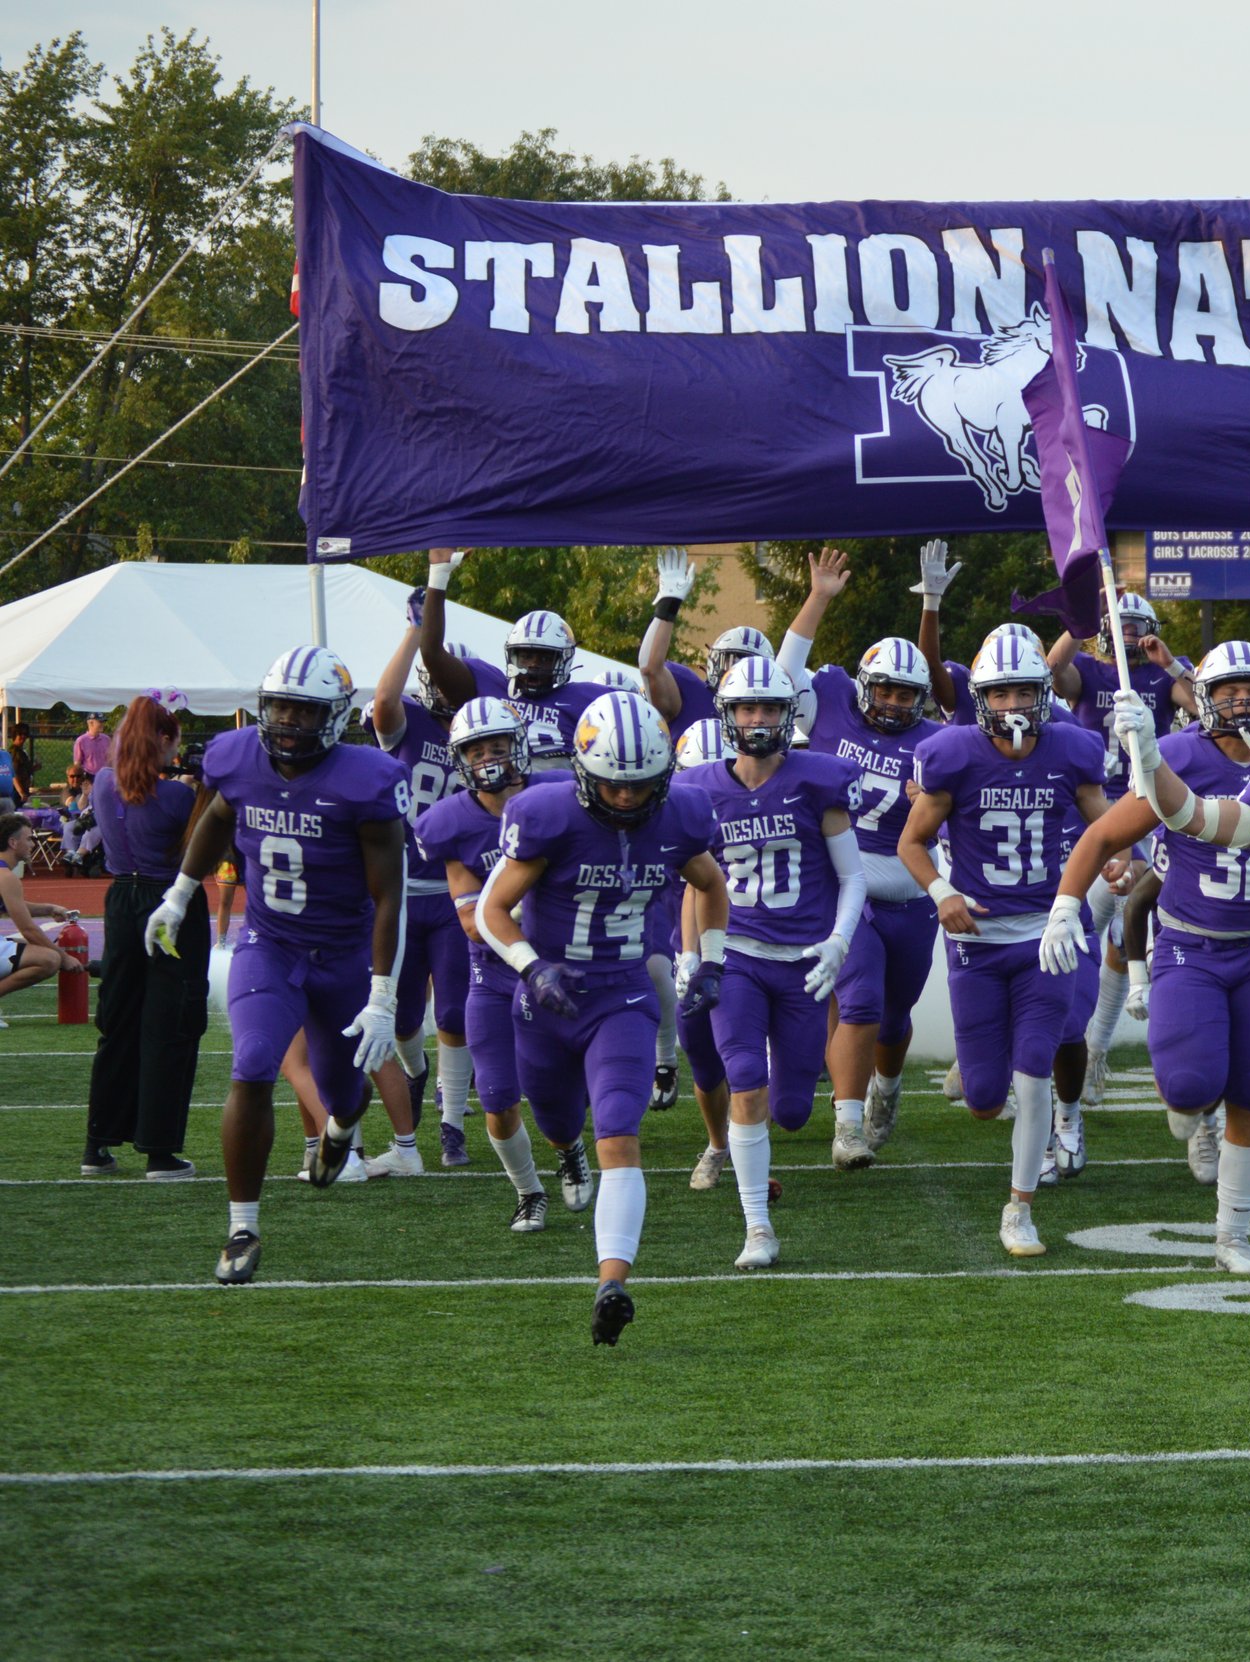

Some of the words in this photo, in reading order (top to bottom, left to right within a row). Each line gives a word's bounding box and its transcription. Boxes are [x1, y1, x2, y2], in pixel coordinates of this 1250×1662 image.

[378, 226, 1026, 335] STALLION
[1154, 545, 1183, 559] GIRLS
[1188, 545, 1239, 559] LACROSSE
[1150, 574, 1191, 586] TNT
[245, 806, 322, 838] DESALES
[980, 788, 1054, 809] DESALES
[720, 814, 796, 844] DESALES
[979, 810, 1047, 885] 31
[260, 835, 307, 915] 8
[723, 838, 801, 908] 80
[565, 890, 653, 960] 14
